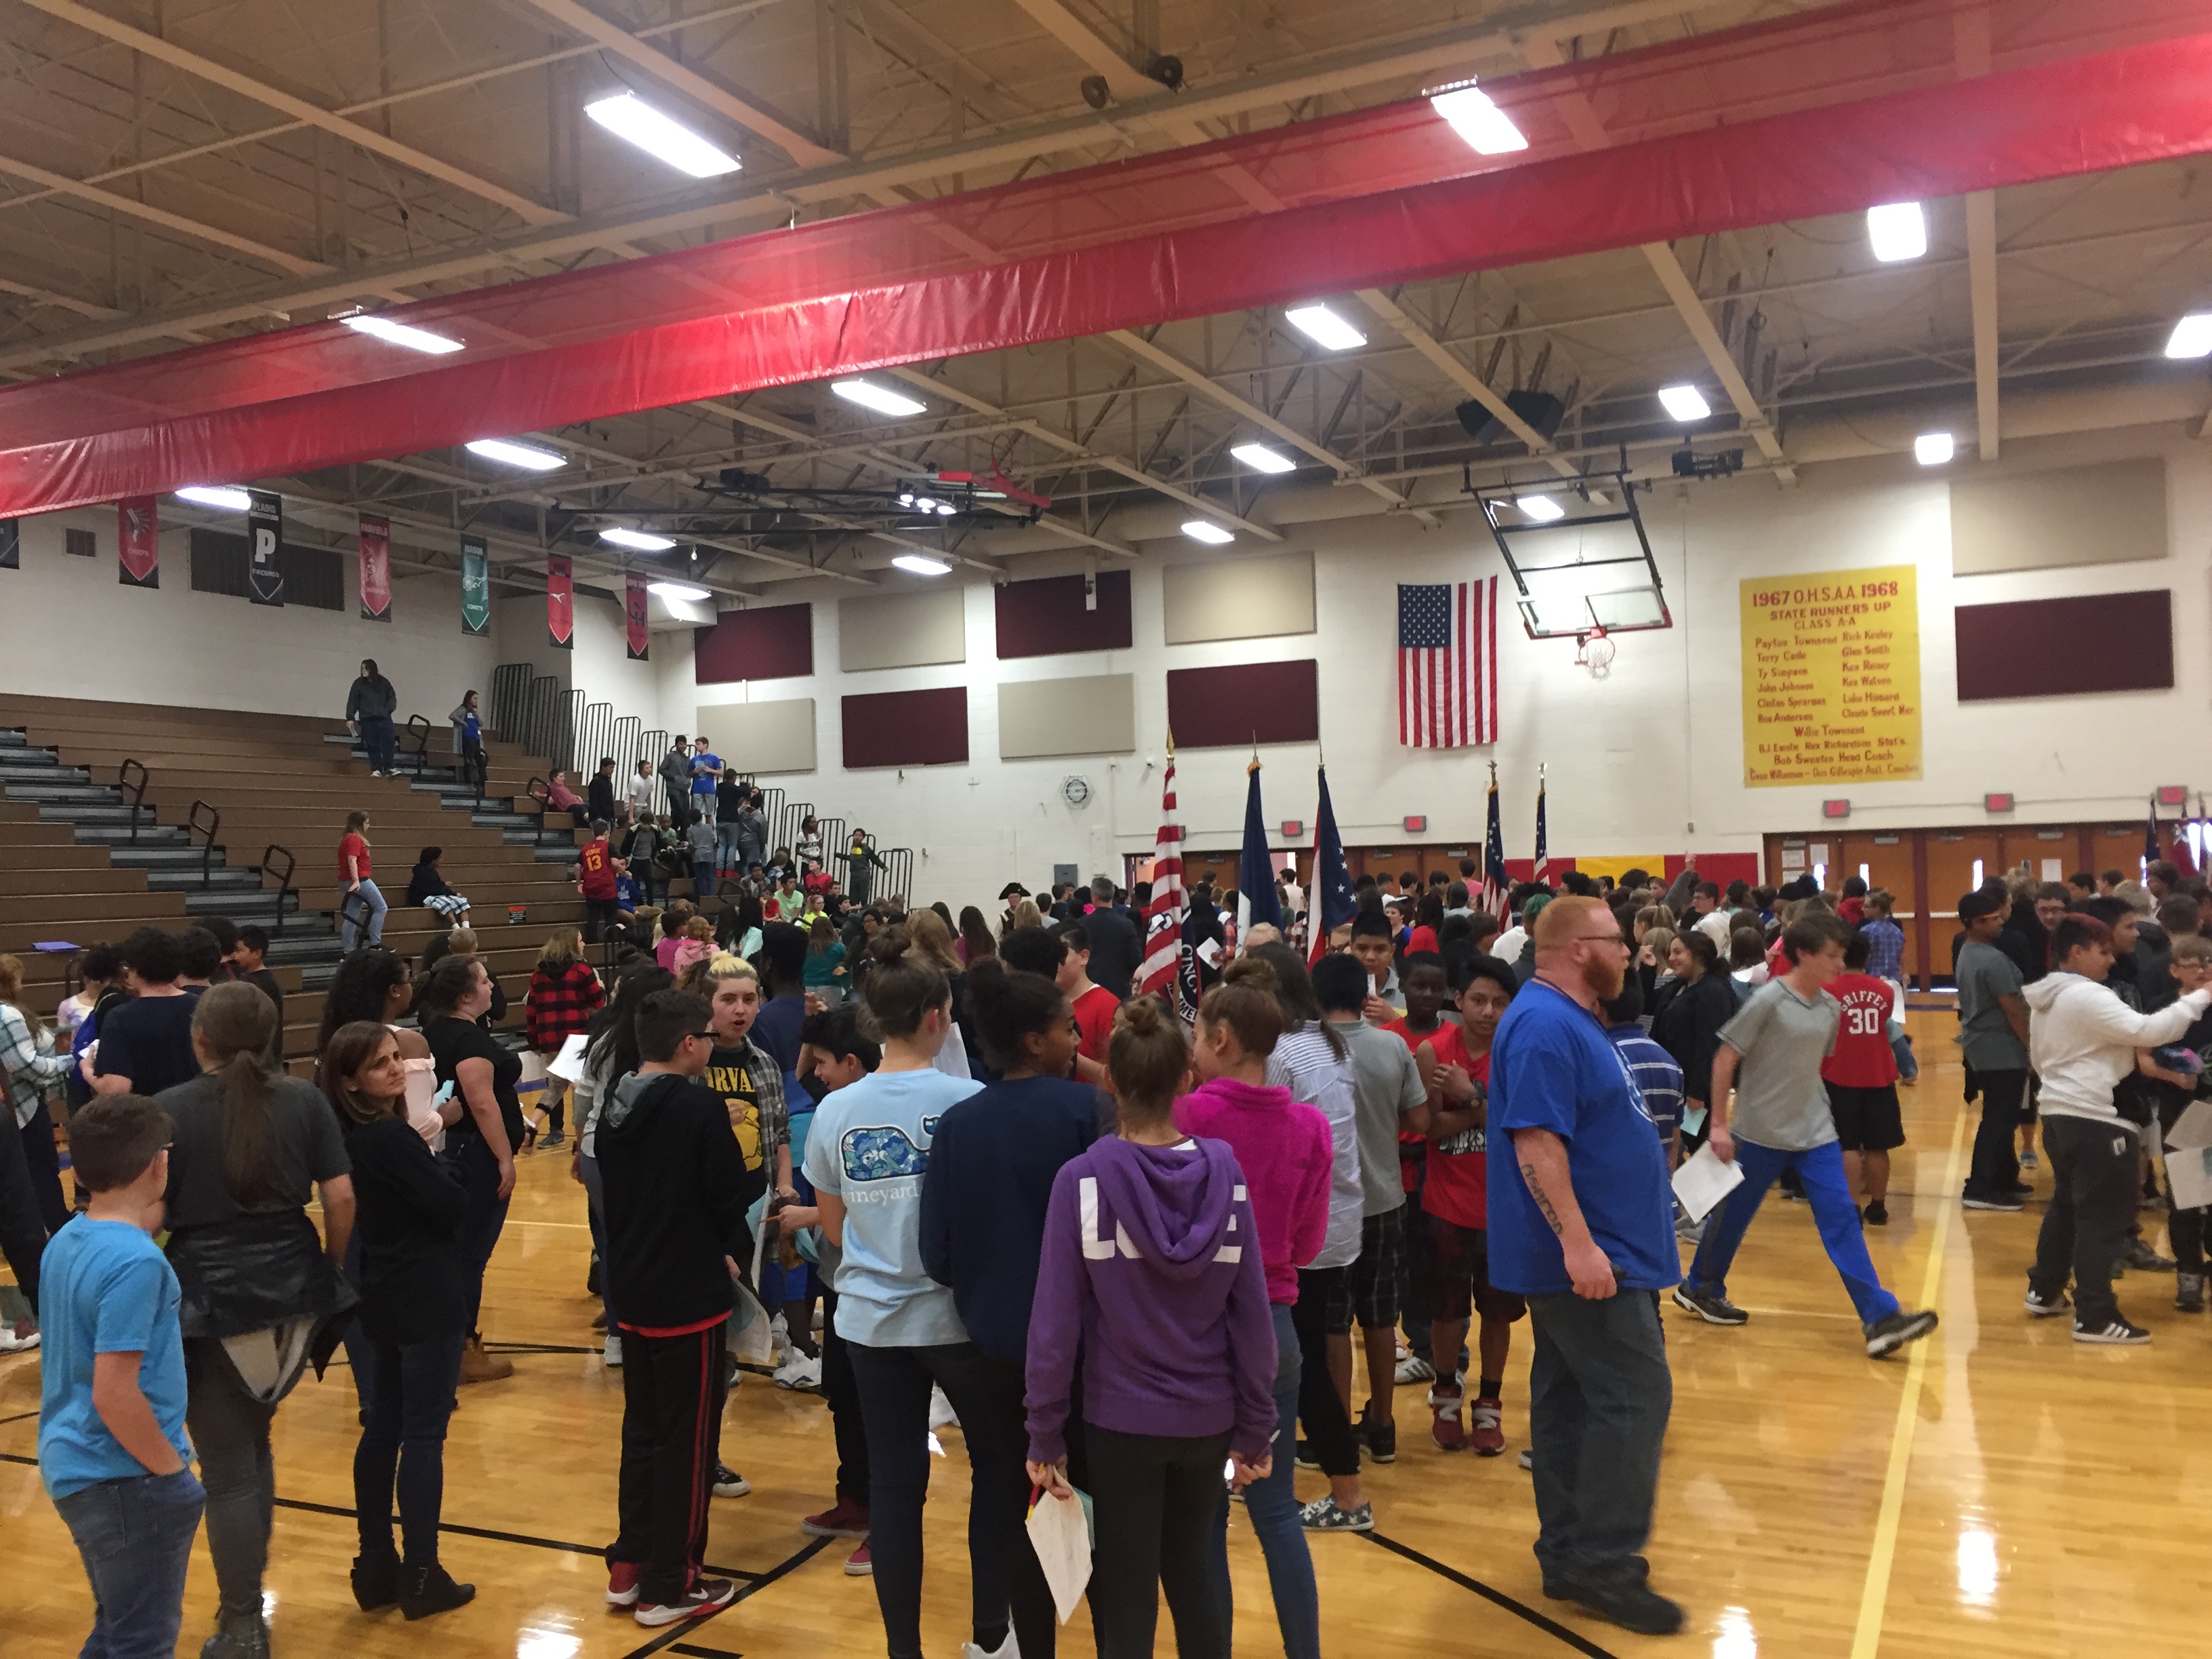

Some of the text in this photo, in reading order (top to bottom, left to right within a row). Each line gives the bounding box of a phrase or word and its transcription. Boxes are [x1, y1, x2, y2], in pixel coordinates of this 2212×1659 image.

[255, 528, 276, 563] P
[1753, 590, 1790, 607] 1967
[1861, 581, 1898, 598] 1968
[1770, 601, 1891, 621] STATE RUNNERS UP
[1794, 617, 1832, 631] CLASS
[1755, 634, 1837, 651] Payton Townsend
[1843, 630, 1862, 641] Rick
[1864, 644, 1890, 655] Smith
[1757, 652, 1779, 664] Terry
[1771, 667, 1808, 680] Simpson
[1757, 682, 1814, 693] John Johnson
[1774, 712, 1814, 722] Anderson
[1793, 724, 1865, 738] Willie Townsend
[1774, 754, 1793, 766] Bob
[1864, 749, 1893, 762] Coach
[587, 855, 602, 872] 13
[1847, 1007, 1879, 1035] 30
